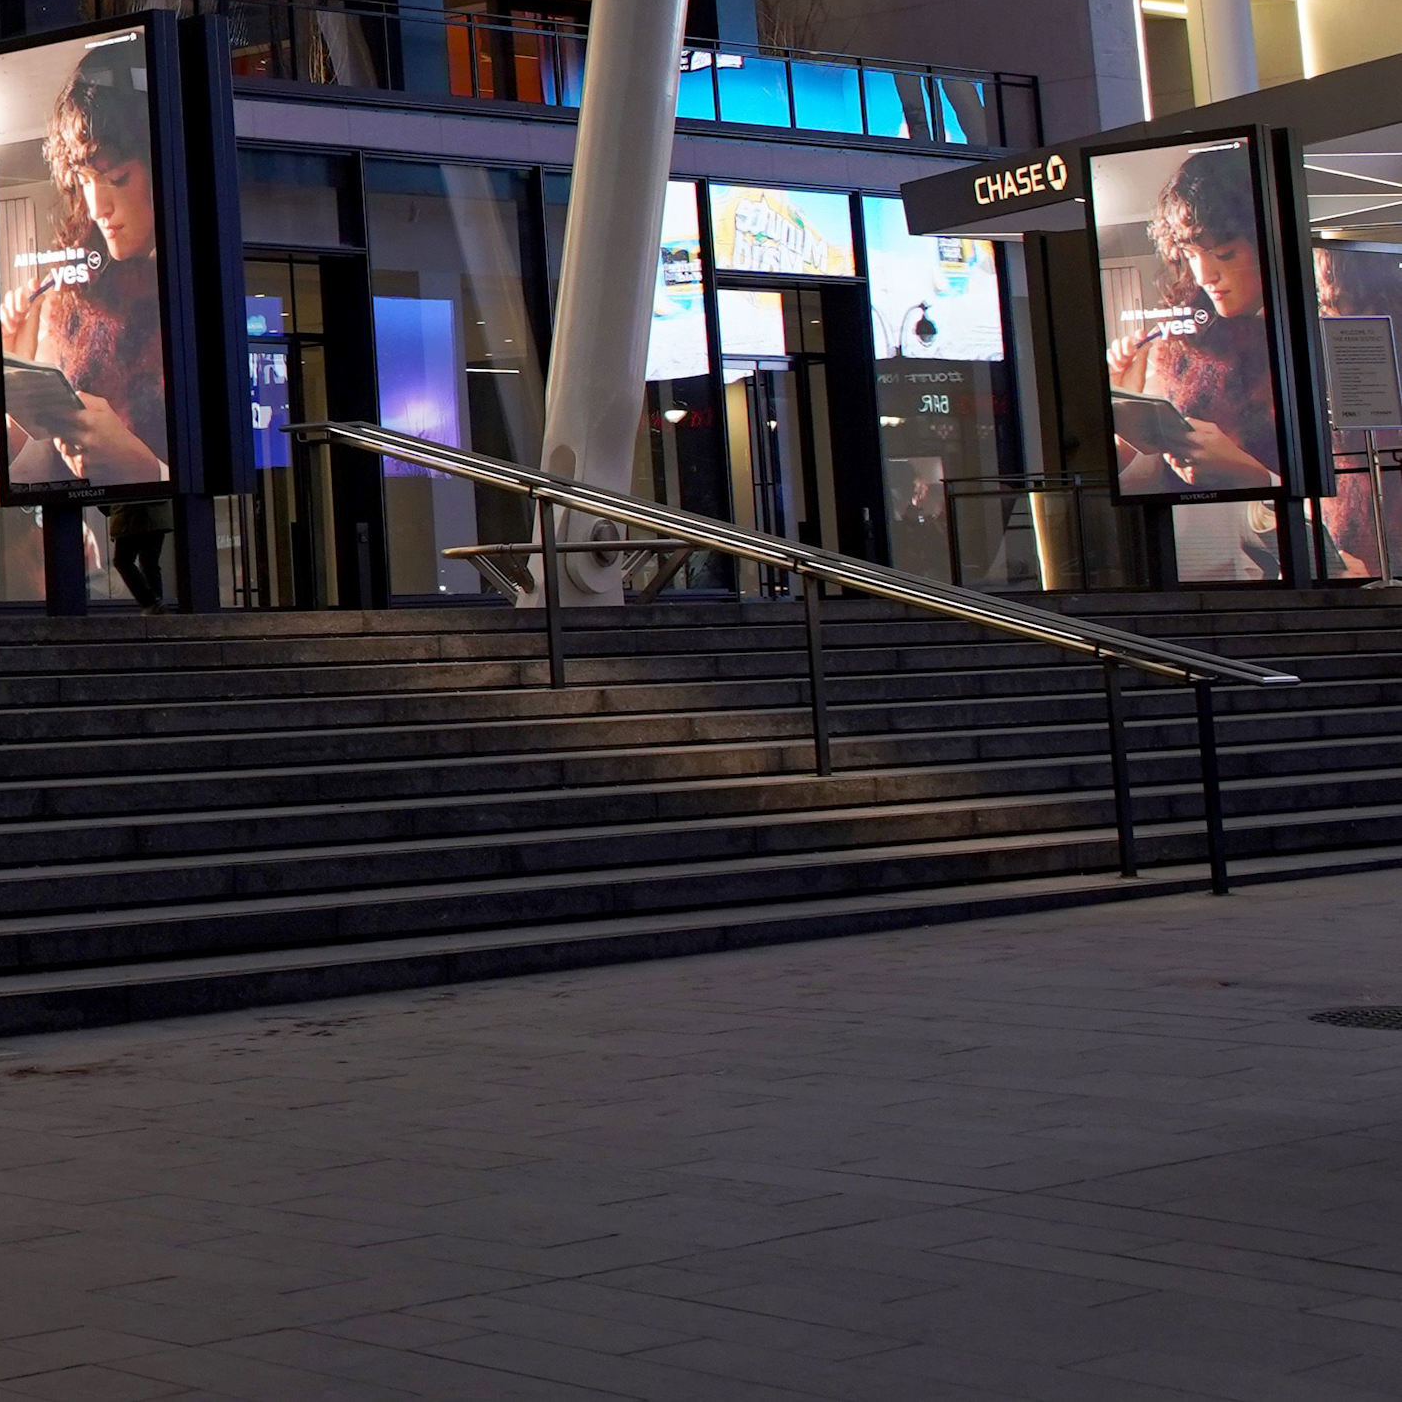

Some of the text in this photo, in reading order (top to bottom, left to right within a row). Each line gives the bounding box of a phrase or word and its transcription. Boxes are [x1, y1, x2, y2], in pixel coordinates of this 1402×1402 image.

[974, 162, 1046, 205] CHASE
[50, 263, 89, 291] yes
[1157, 319, 1196, 340] yes
[67, 488, 106, 499] SILVERCAST
